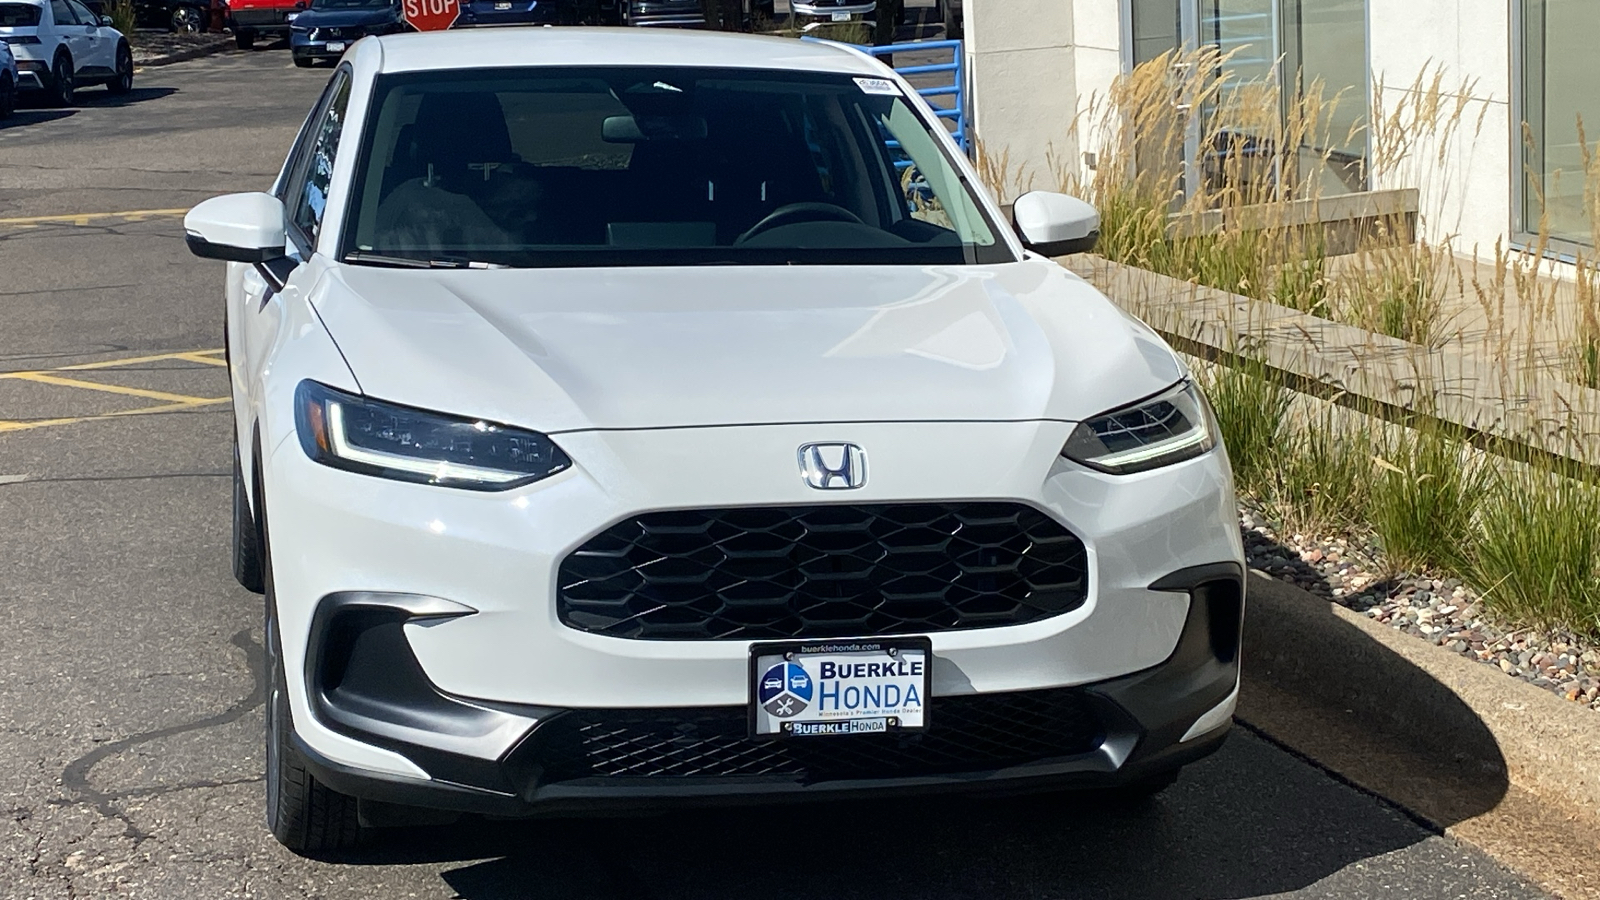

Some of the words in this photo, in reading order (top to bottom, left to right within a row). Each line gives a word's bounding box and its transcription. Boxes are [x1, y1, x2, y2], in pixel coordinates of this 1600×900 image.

[407, 0, 454, 17] STOP
[801, 643, 880, 653] buerklehonda.com
[820, 661, 922, 679] BUERKLE
[819, 681, 921, 710] HONDA
[793, 722, 849, 734] BUERKLE
[851, 721, 884, 732] HONDA
